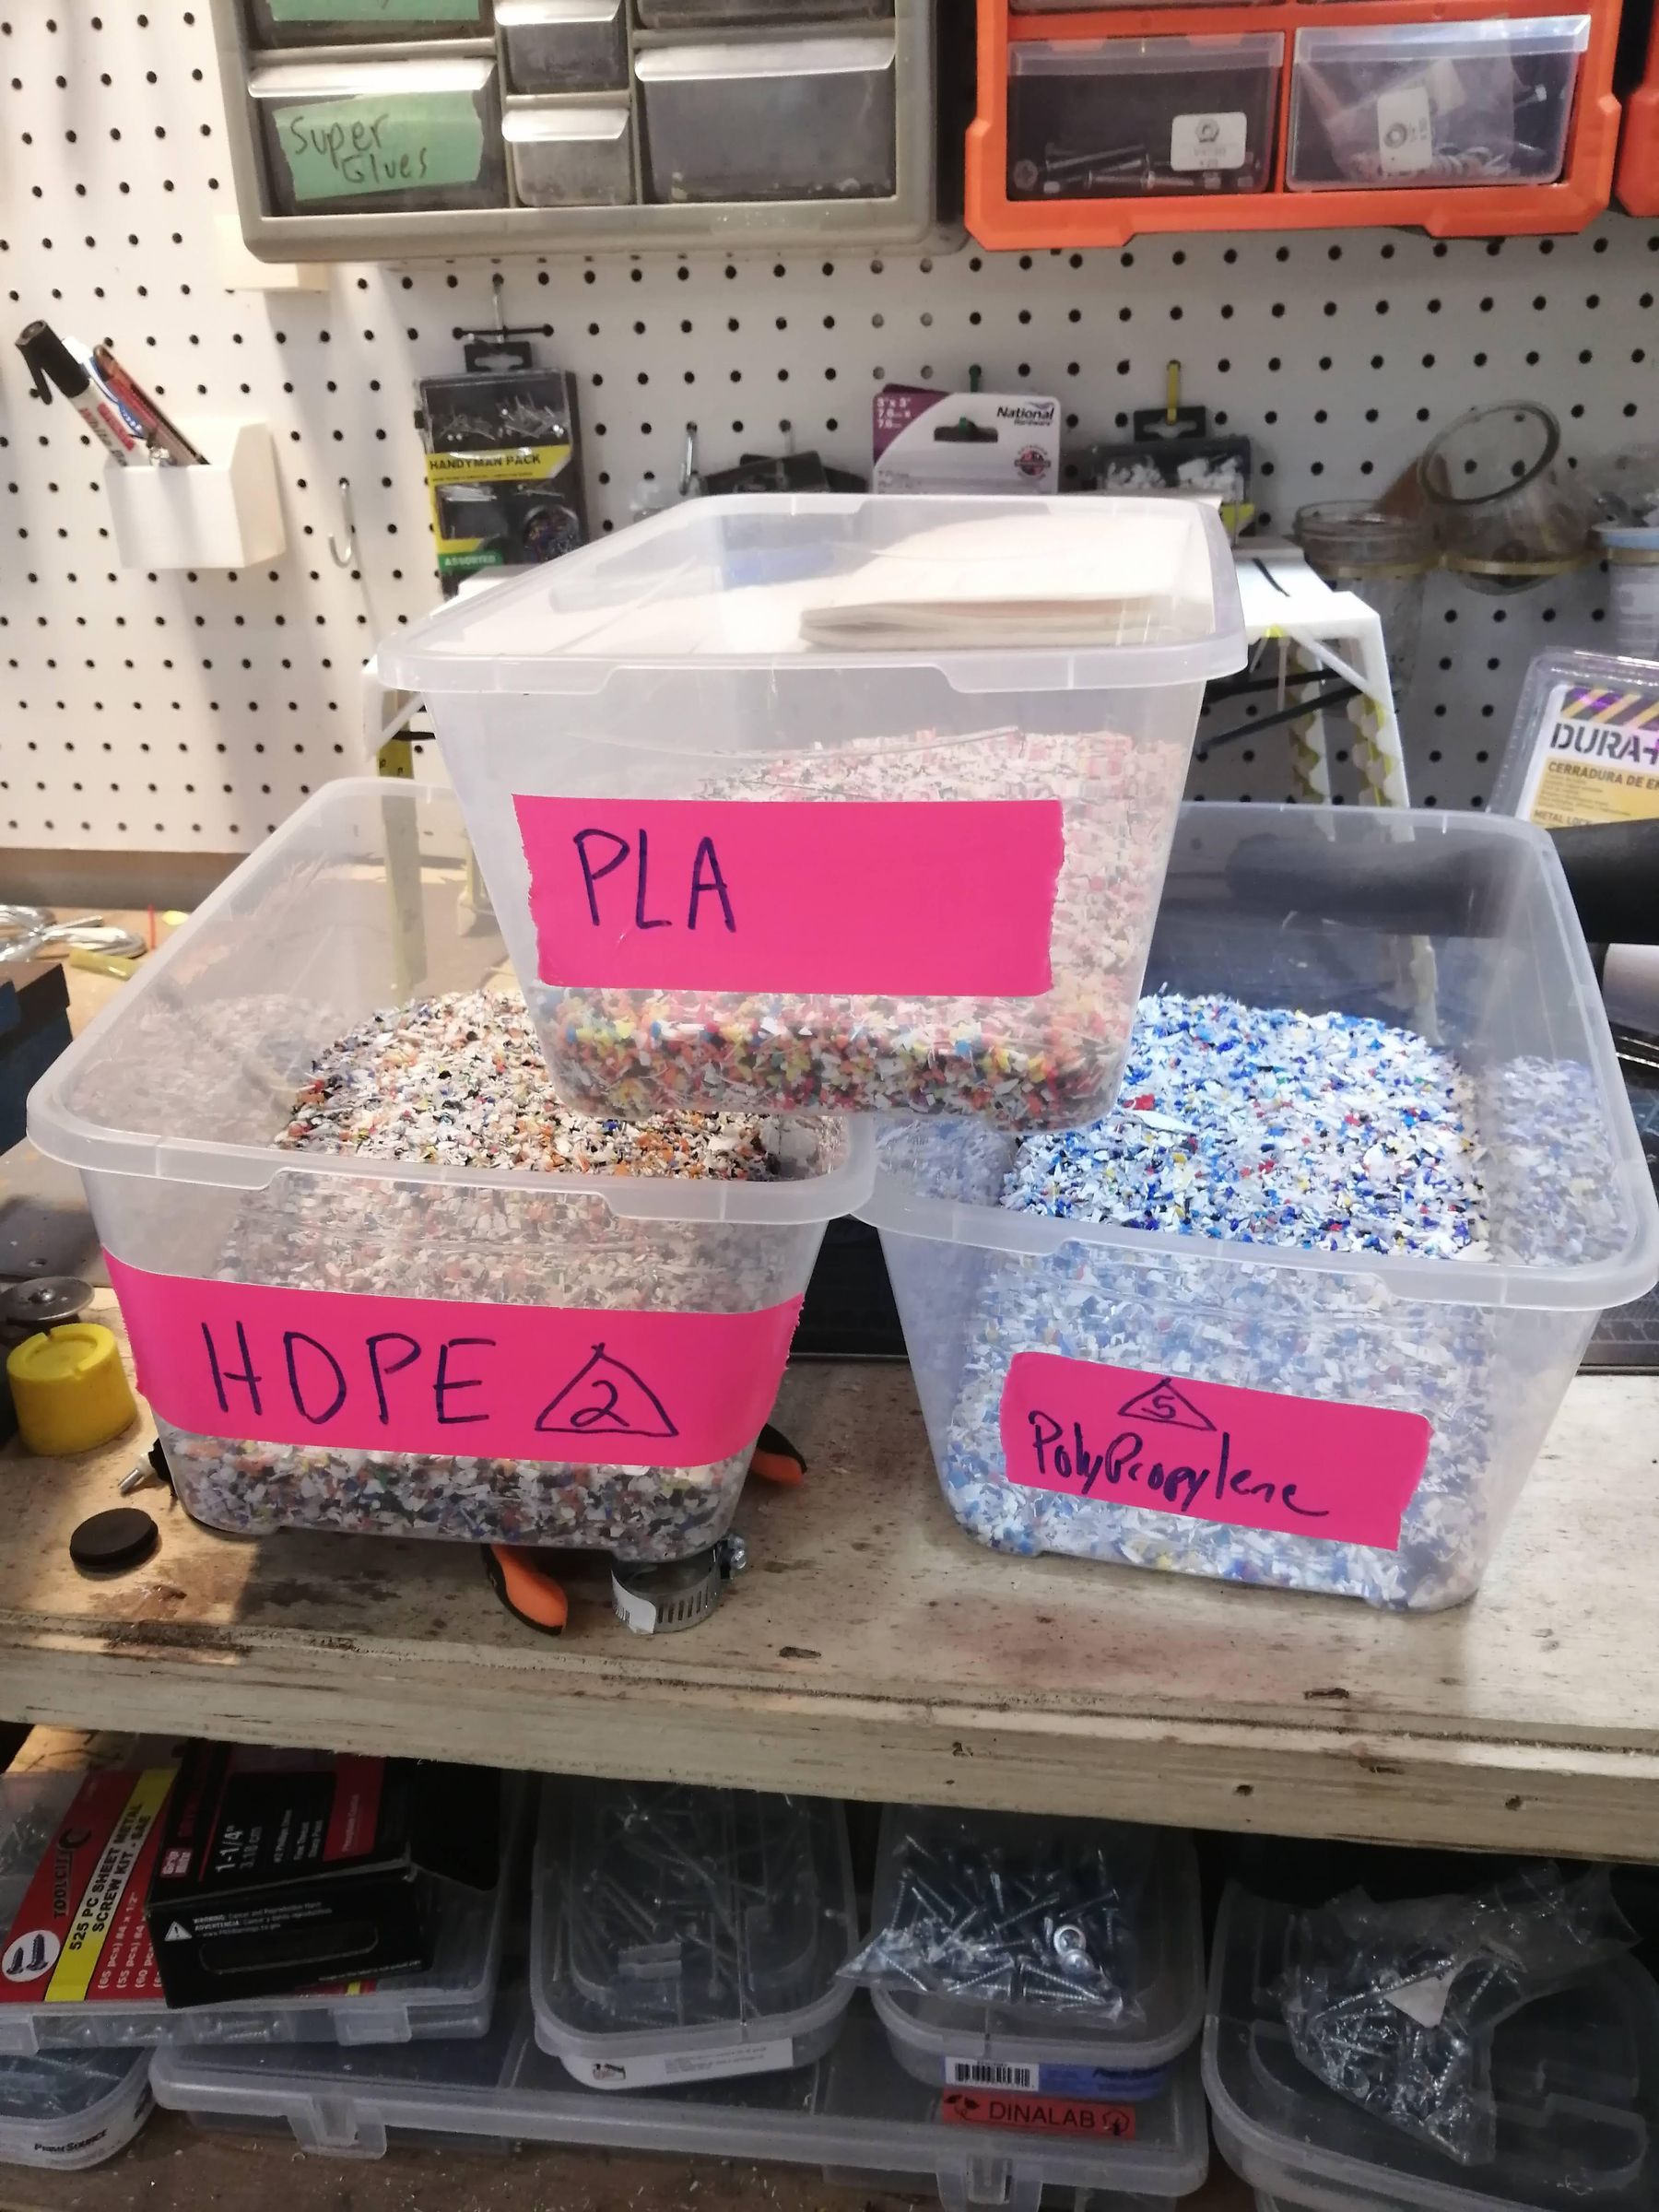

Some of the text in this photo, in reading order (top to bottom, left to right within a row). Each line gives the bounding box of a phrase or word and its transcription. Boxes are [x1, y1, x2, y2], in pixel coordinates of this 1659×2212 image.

[290, 113, 389, 170] Super
[341, 147, 427, 183] Glues
[996, 406, 1054, 420] National
[429, 453, 541, 471] HANDYMAN PACK
[1548, 761, 1622, 784] CERRADURA
[1626, 774, 1642, 788] DE
[572, 829, 736, 933] PLA
[202, 1321, 630, 1429] HDPE 2
[1142, 1394, 1177, 1419] 5
[216, 1825, 243, 1873] 1-1/4"
[69, 1804, 143, 1950] 525 PC SHEET METAL
[92, 1878, 122, 1933] SCREW
[115, 1852, 134, 1875] KIT
[989, 2100, 1095, 2129] DINALAB
